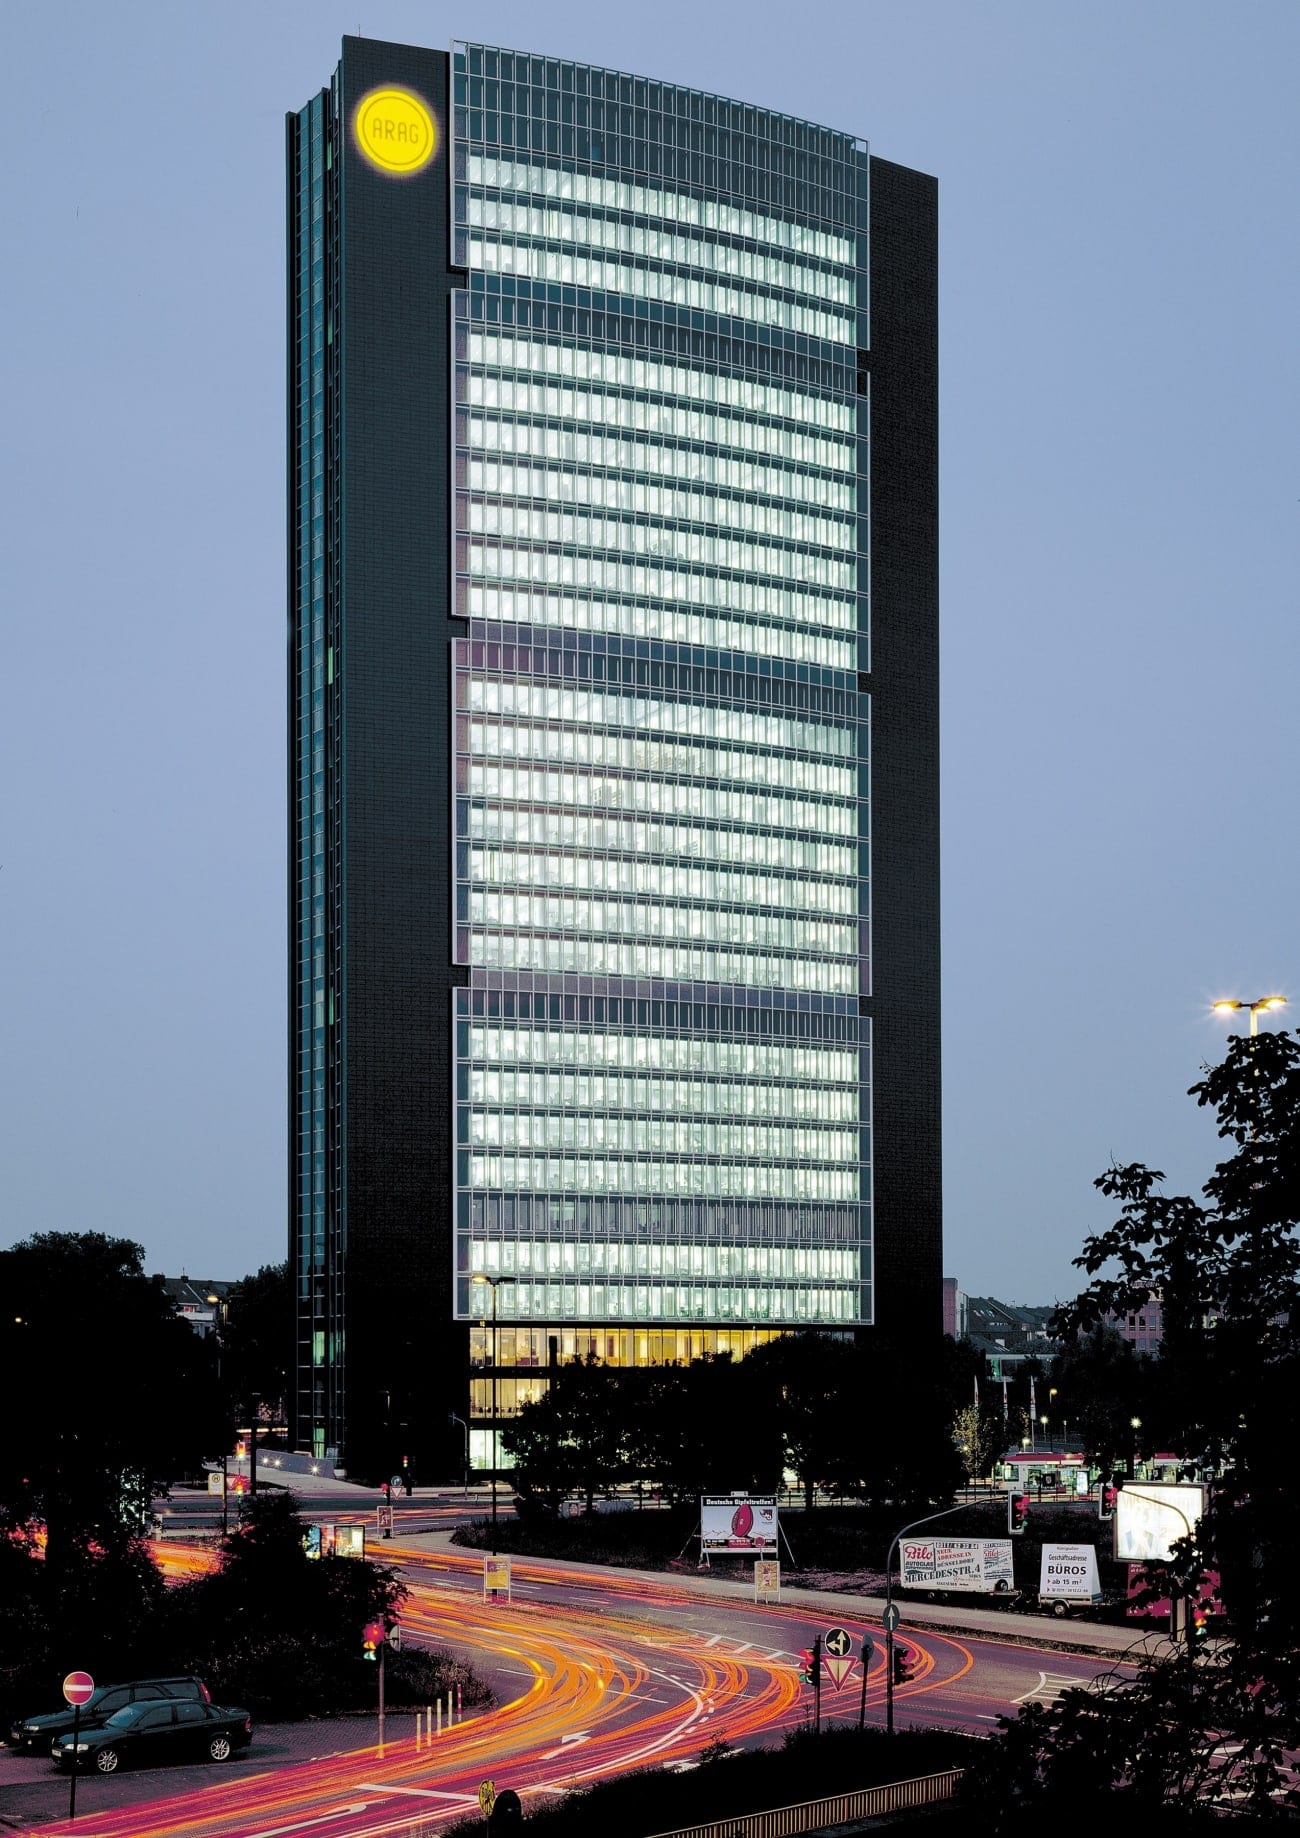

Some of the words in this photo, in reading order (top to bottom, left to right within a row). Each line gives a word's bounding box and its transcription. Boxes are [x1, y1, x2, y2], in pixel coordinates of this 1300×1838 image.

[372, 117, 419, 144] ARAG
[904, 1565, 974, 1583] MERCEDESSTR.
[974, 1563, 981, 1573] 4
[1048, 1563, 1086, 1575] BÜROS
